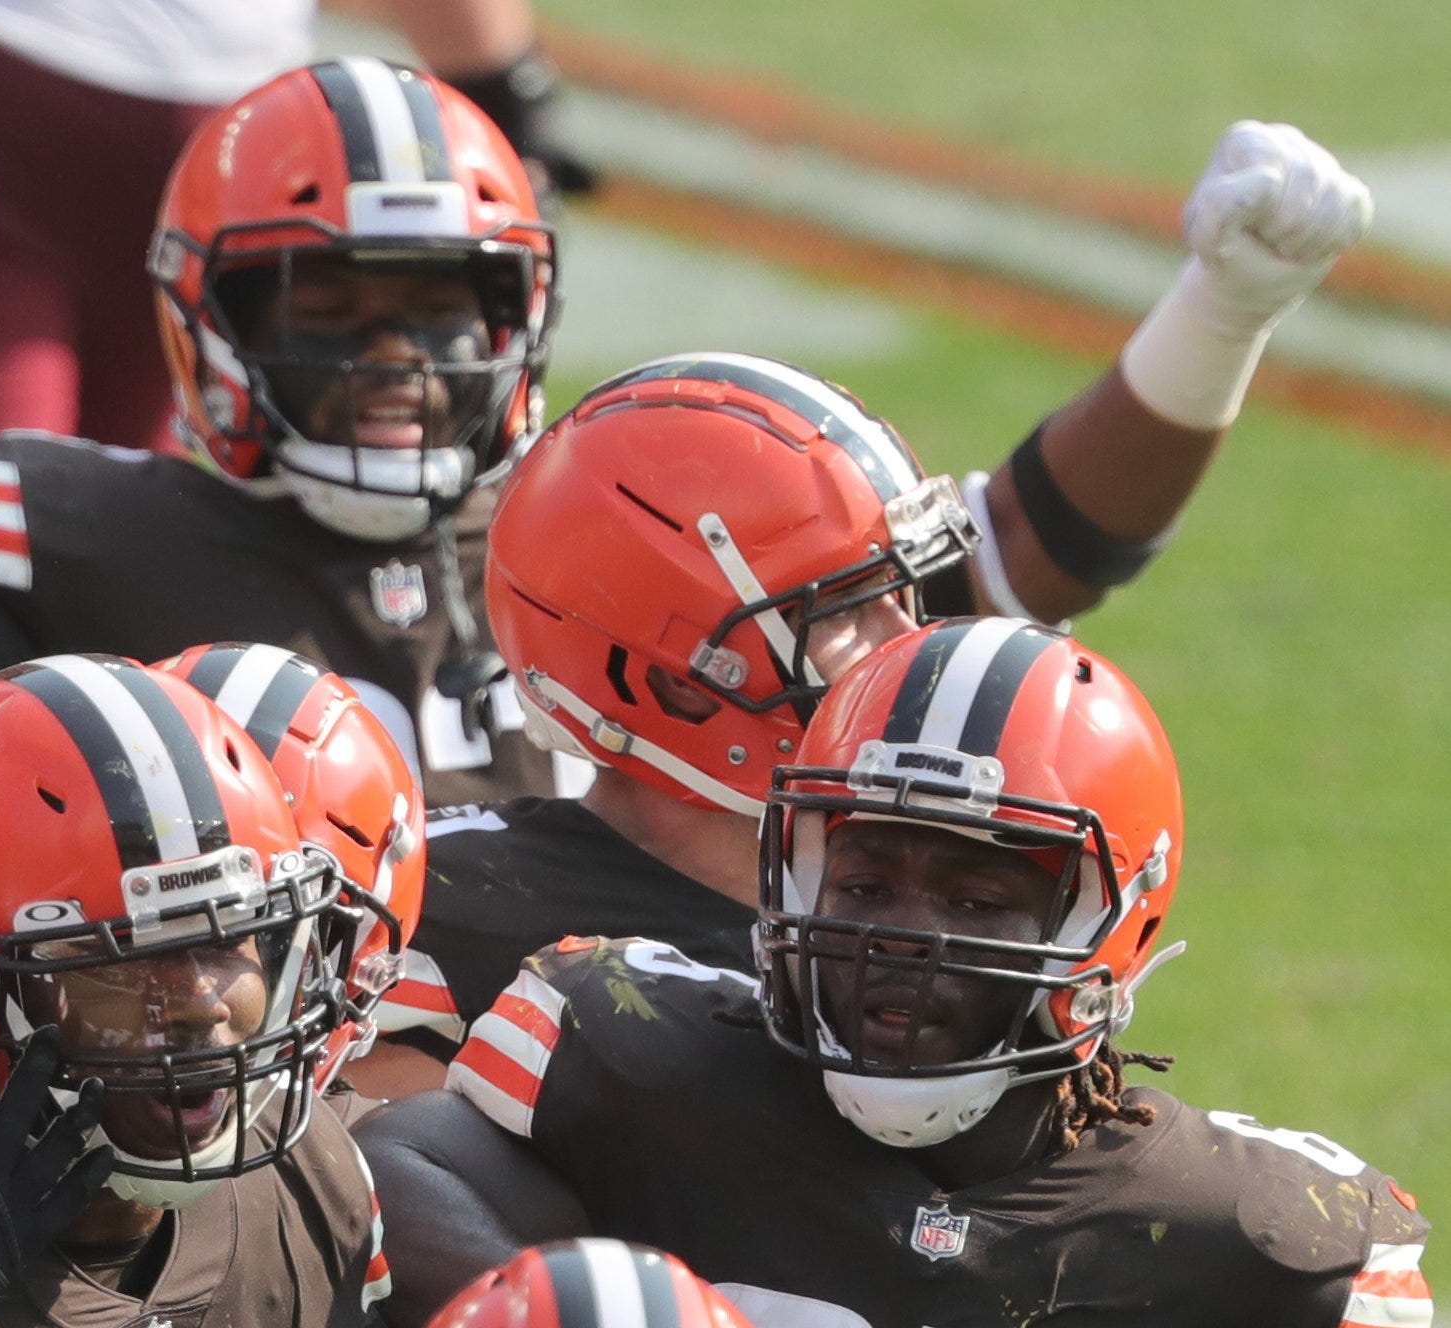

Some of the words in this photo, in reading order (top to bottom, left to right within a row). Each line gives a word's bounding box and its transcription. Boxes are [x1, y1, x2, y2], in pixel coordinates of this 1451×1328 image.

[895, 752, 963, 777] BROWNS
[158, 862, 223, 892] BROWNS
[920, 1227, 956, 1250] NFL
